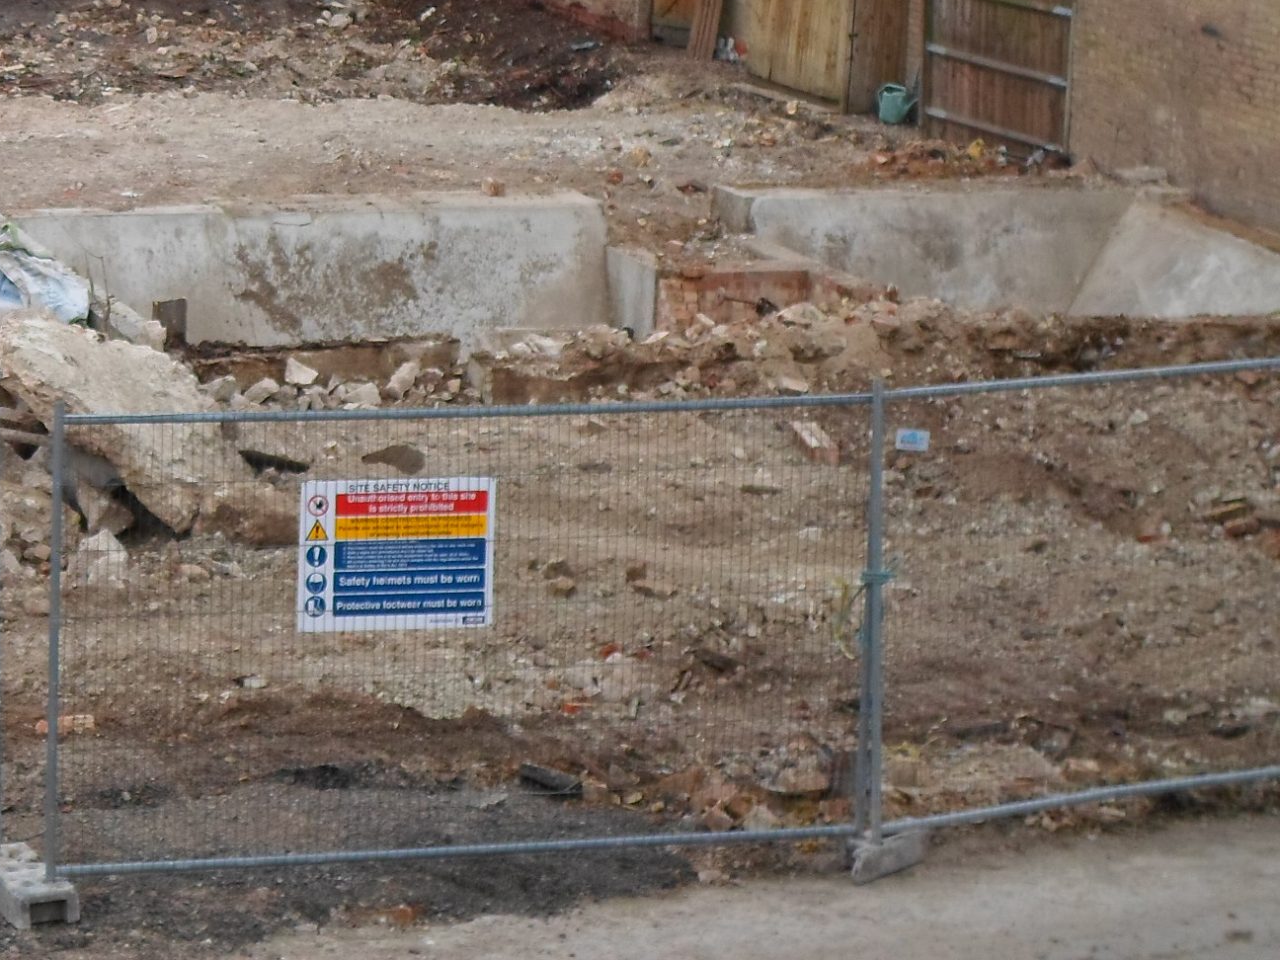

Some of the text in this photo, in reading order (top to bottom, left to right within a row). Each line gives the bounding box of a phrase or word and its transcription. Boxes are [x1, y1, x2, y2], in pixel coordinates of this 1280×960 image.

[349, 482, 450, 493] SITE SAFETY NOTICE
[408, 493, 429, 503] entry
[442, 492, 458, 500] this
[460, 491, 476, 500] site
[379, 503, 408, 513] strictly
[410, 502, 454, 513] prohibited
[339, 574, 480, 588] Safety helmets must be worn
[336, 599, 482, 611] Protective footwear must be worn
